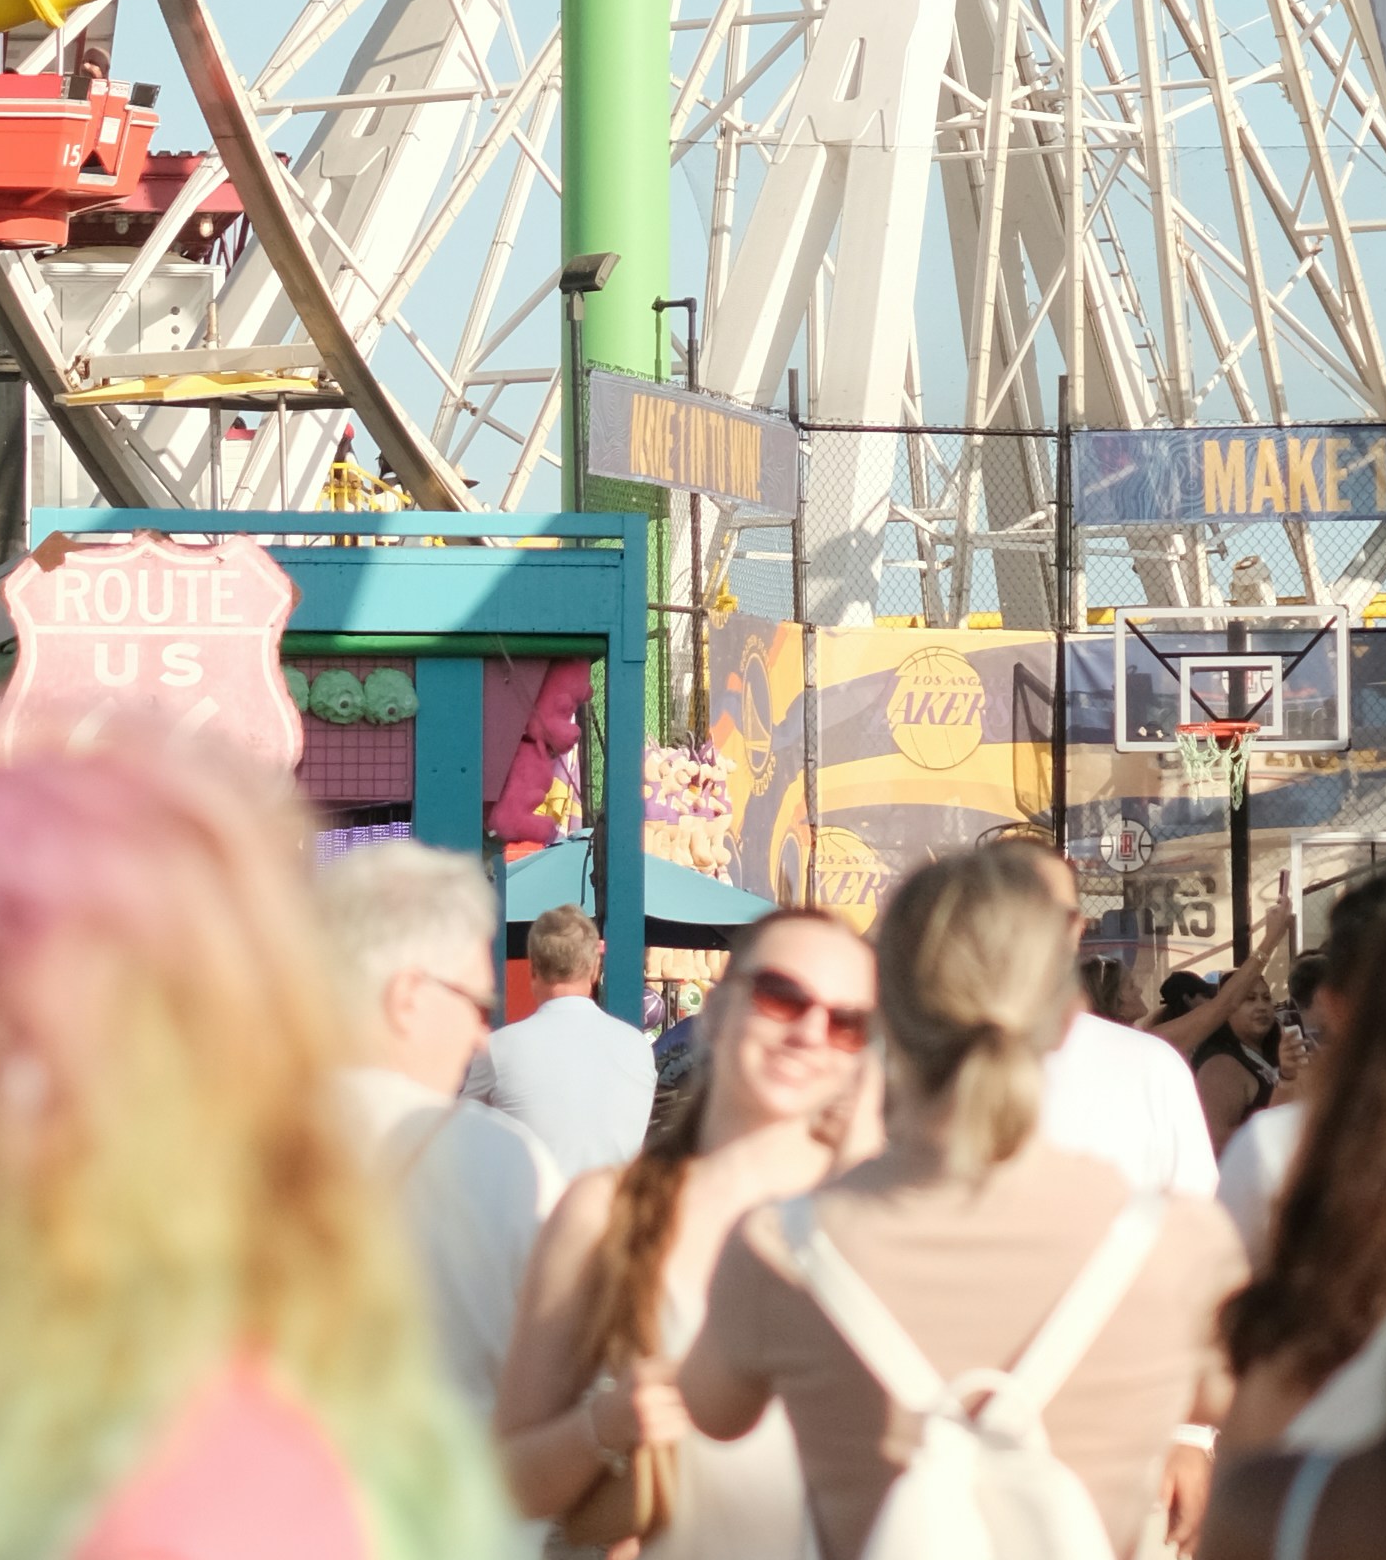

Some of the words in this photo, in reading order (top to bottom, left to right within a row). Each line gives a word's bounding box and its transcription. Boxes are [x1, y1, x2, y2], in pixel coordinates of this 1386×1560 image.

[63, 143, 81, 167] 15
[1203, 437, 1351, 514] MAKE
[54, 568, 244, 624] ROUTE
